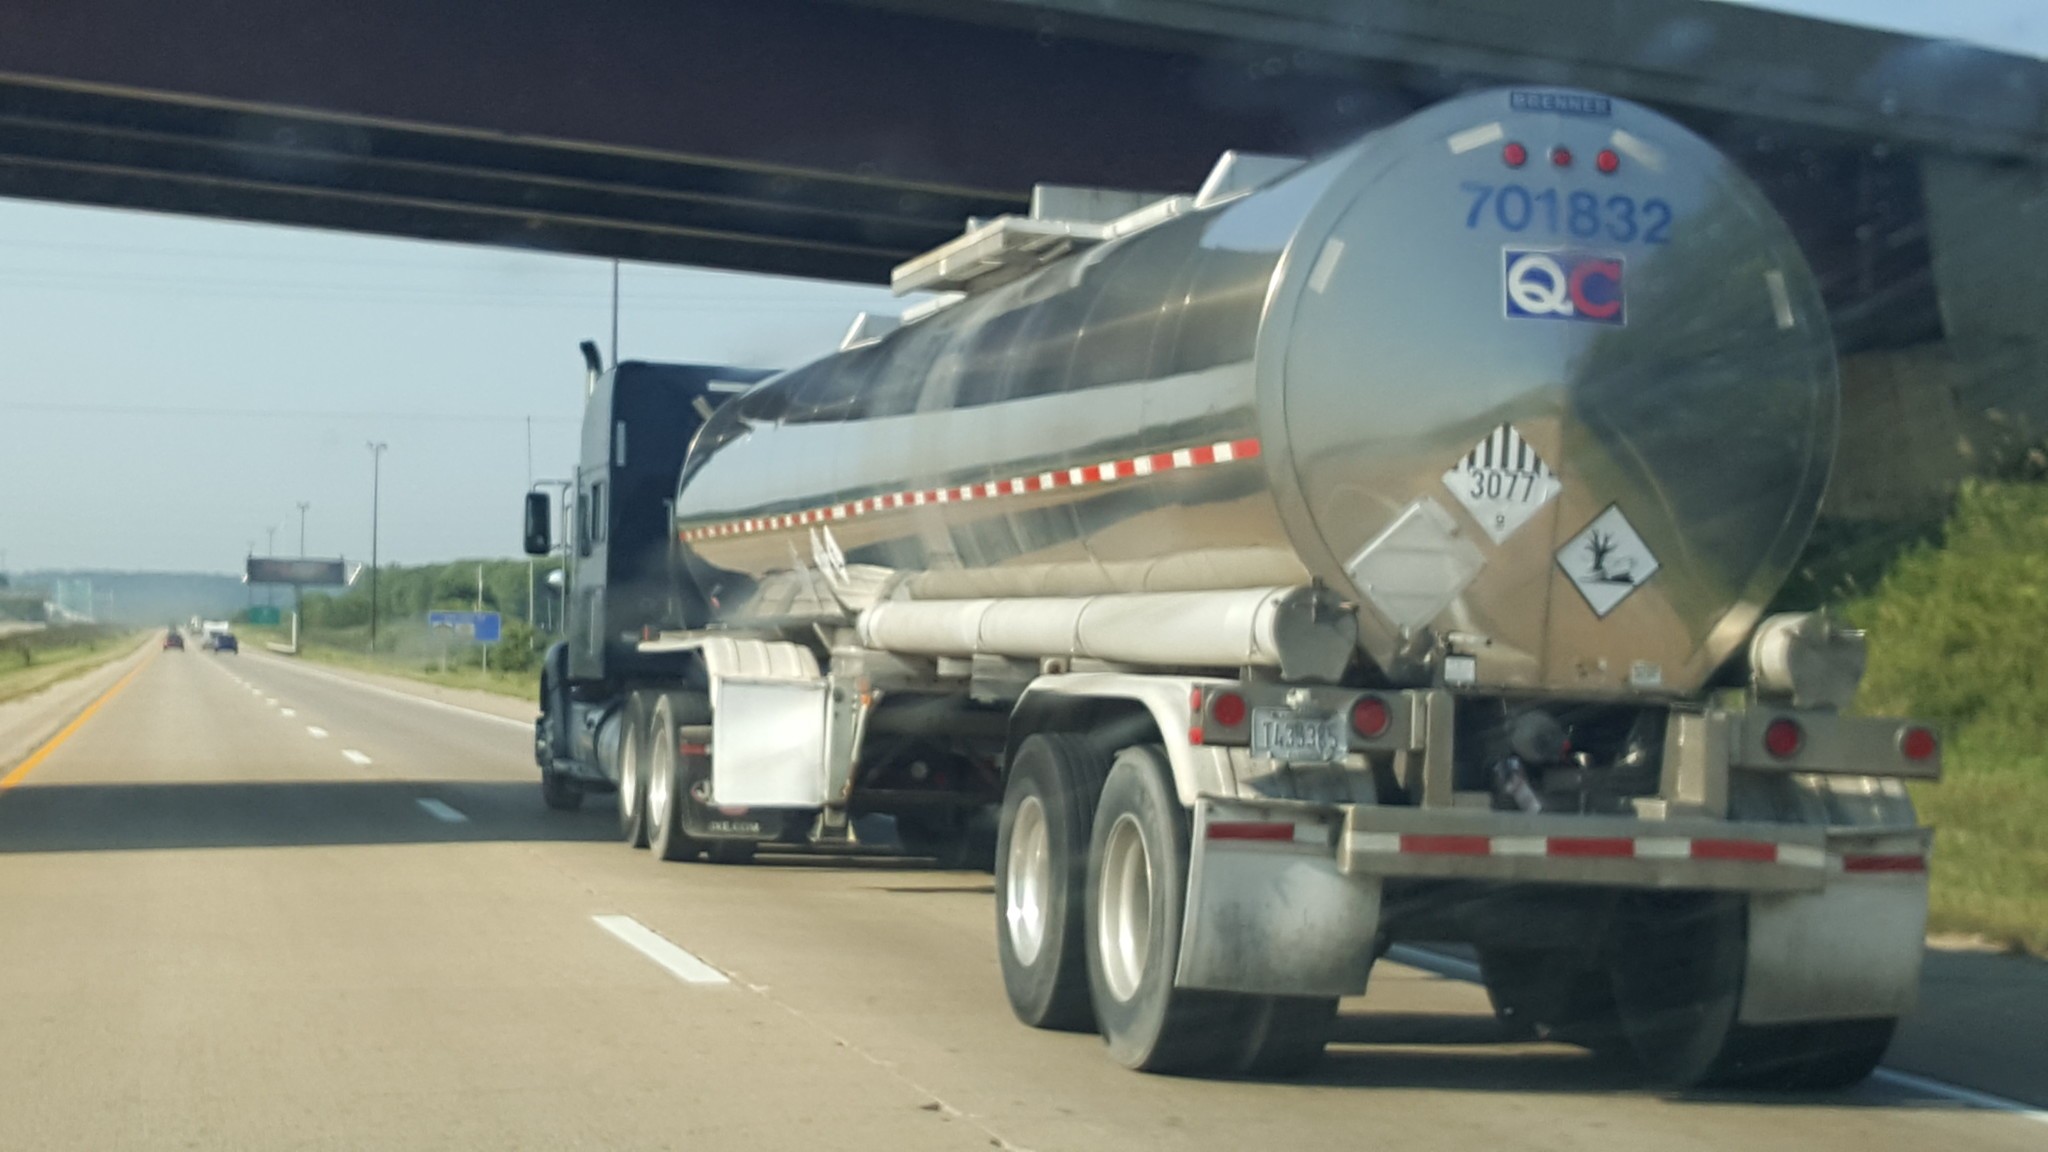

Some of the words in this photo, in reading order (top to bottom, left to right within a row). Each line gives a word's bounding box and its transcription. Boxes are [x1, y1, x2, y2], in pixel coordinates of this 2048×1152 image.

[1512, 92, 1608, 114] BRENNER
[1460, 181, 1674, 245] 701832
[1509, 255, 1621, 318] QC
[1470, 468, 1536, 502] 3077
